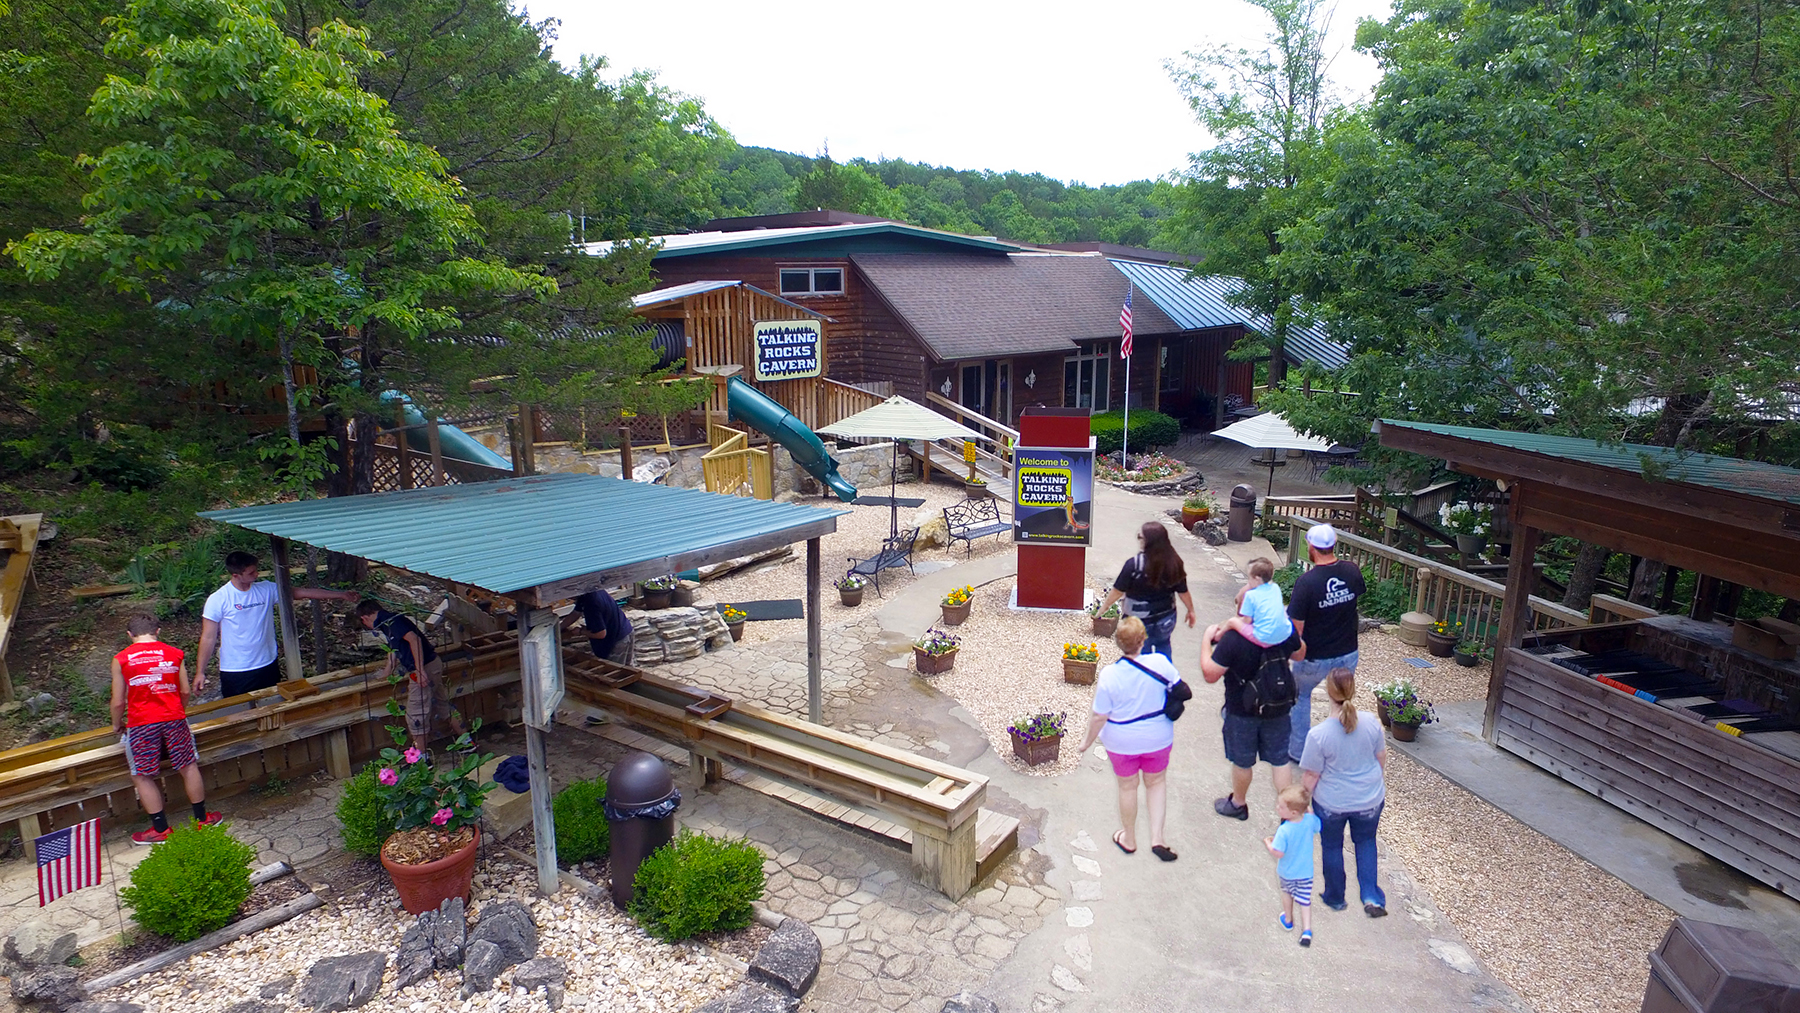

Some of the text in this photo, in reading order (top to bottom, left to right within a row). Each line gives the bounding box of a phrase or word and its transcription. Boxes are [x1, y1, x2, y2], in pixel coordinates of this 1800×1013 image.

[758, 333, 816, 346] TALKING
[764, 345, 811, 359] ROCKS
[760, 358, 816, 372] CAVERN
[1019, 457, 1069, 466] Welcome to
[1022, 475, 1068, 484] TALKING
[1026, 484, 1063, 493] ROCKS
[1022, 492, 1067, 502] CAVERN
[1326, 588, 1350, 600] DUCKS
[1318, 592, 1355, 609] UNLIMITED
